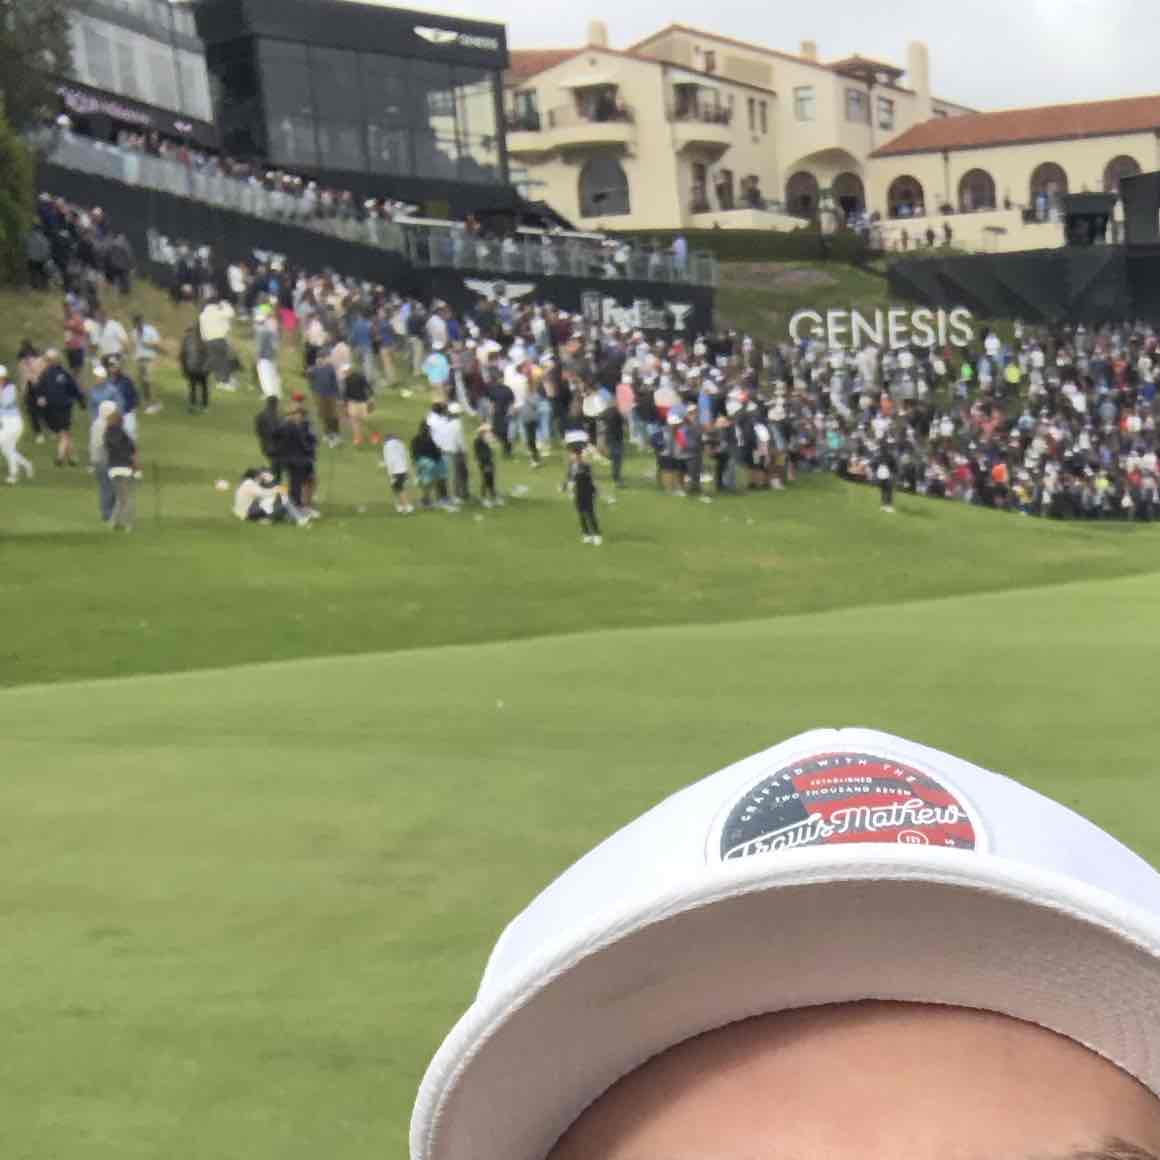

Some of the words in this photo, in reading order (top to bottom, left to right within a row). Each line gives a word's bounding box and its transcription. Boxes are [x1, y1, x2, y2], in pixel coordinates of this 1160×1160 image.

[788, 307, 975, 352] GENESIS
[816, 757, 868, 767] WITH
[775, 791, 800, 803] TWO
[806, 785, 870, 797] THOUSAND
